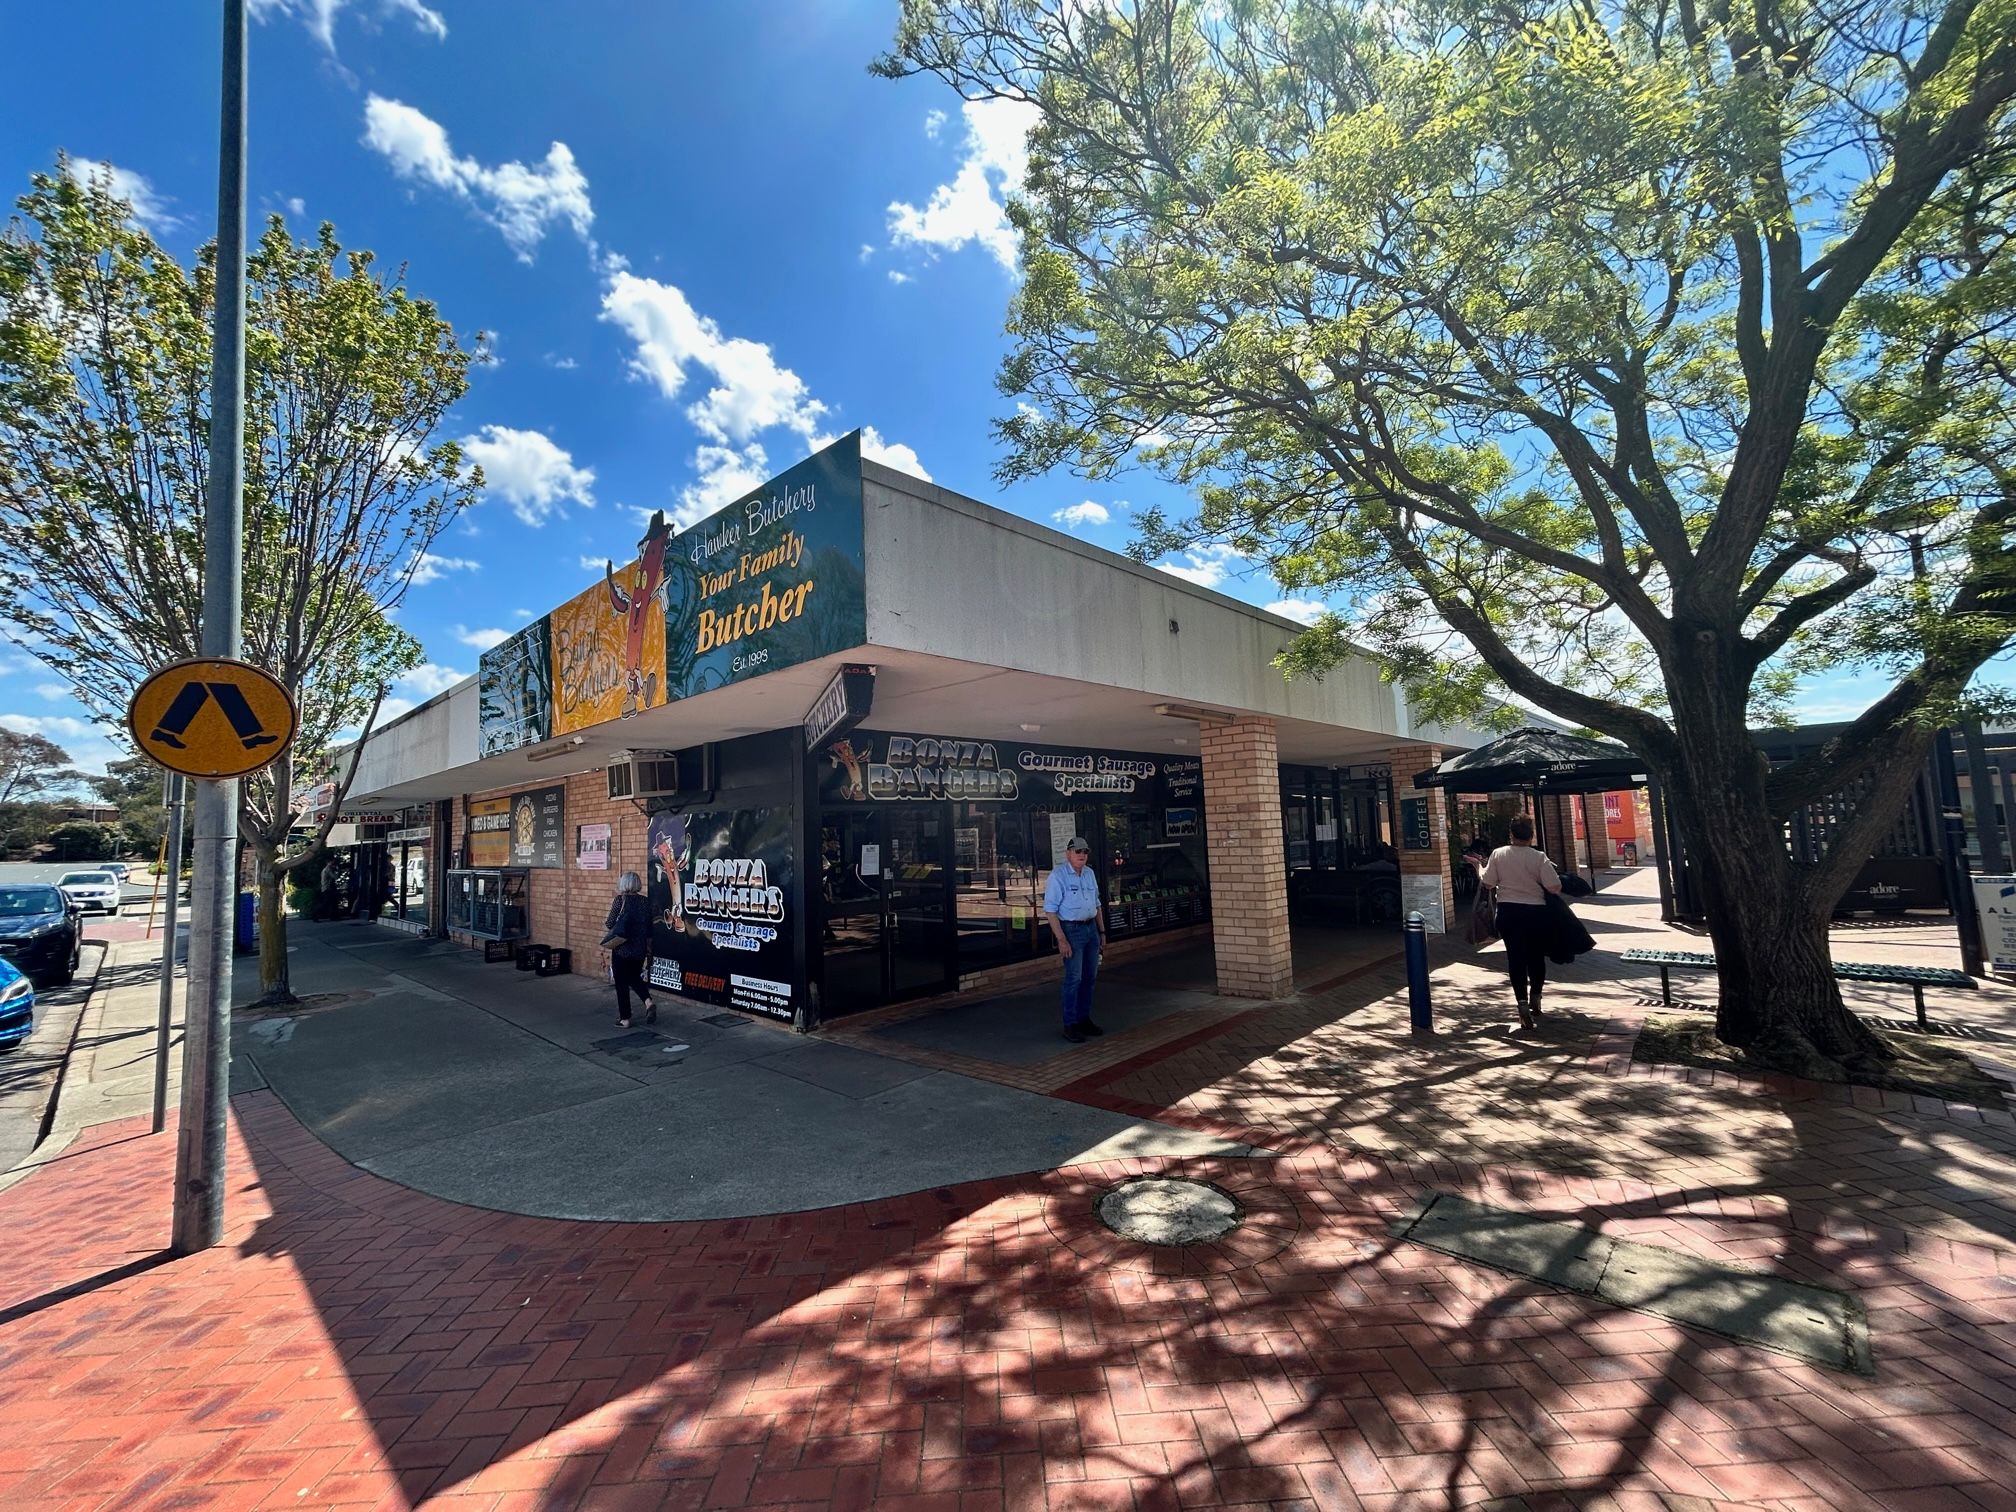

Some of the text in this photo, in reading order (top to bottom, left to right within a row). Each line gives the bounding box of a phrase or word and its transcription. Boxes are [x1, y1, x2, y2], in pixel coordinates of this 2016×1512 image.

[690, 484, 816, 565] Hawker Butchery
[699, 529, 804, 601] Your Family
[695, 580, 814, 654] Butcher
[803, 677, 847, 746] BUTCHERY
[887, 737, 999, 769] BONZA
[1018, 751, 1155, 779] Gourmet Sausage
[1551, 761, 1576, 772] adore
[868, 764, 1018, 800] BANGERS
[1054, 773, 1135, 796] Specialists
[1168, 776, 1198, 788] Traditional
[1174, 788, 1193, 798] Service
[360, 815, 395, 823] BREAD
[1417, 799, 1430, 848] COFFEE
[694, 859, 768, 889] BONZA
[1869, 882, 1900, 895] adore
[685, 883, 783, 921] BANGERS
[696, 918, 777, 942] Gourmet Sausage
[712, 932, 760, 952] Specialists
[685, 972, 699, 989] FREE
[741, 978, 779, 992] Business Hours
